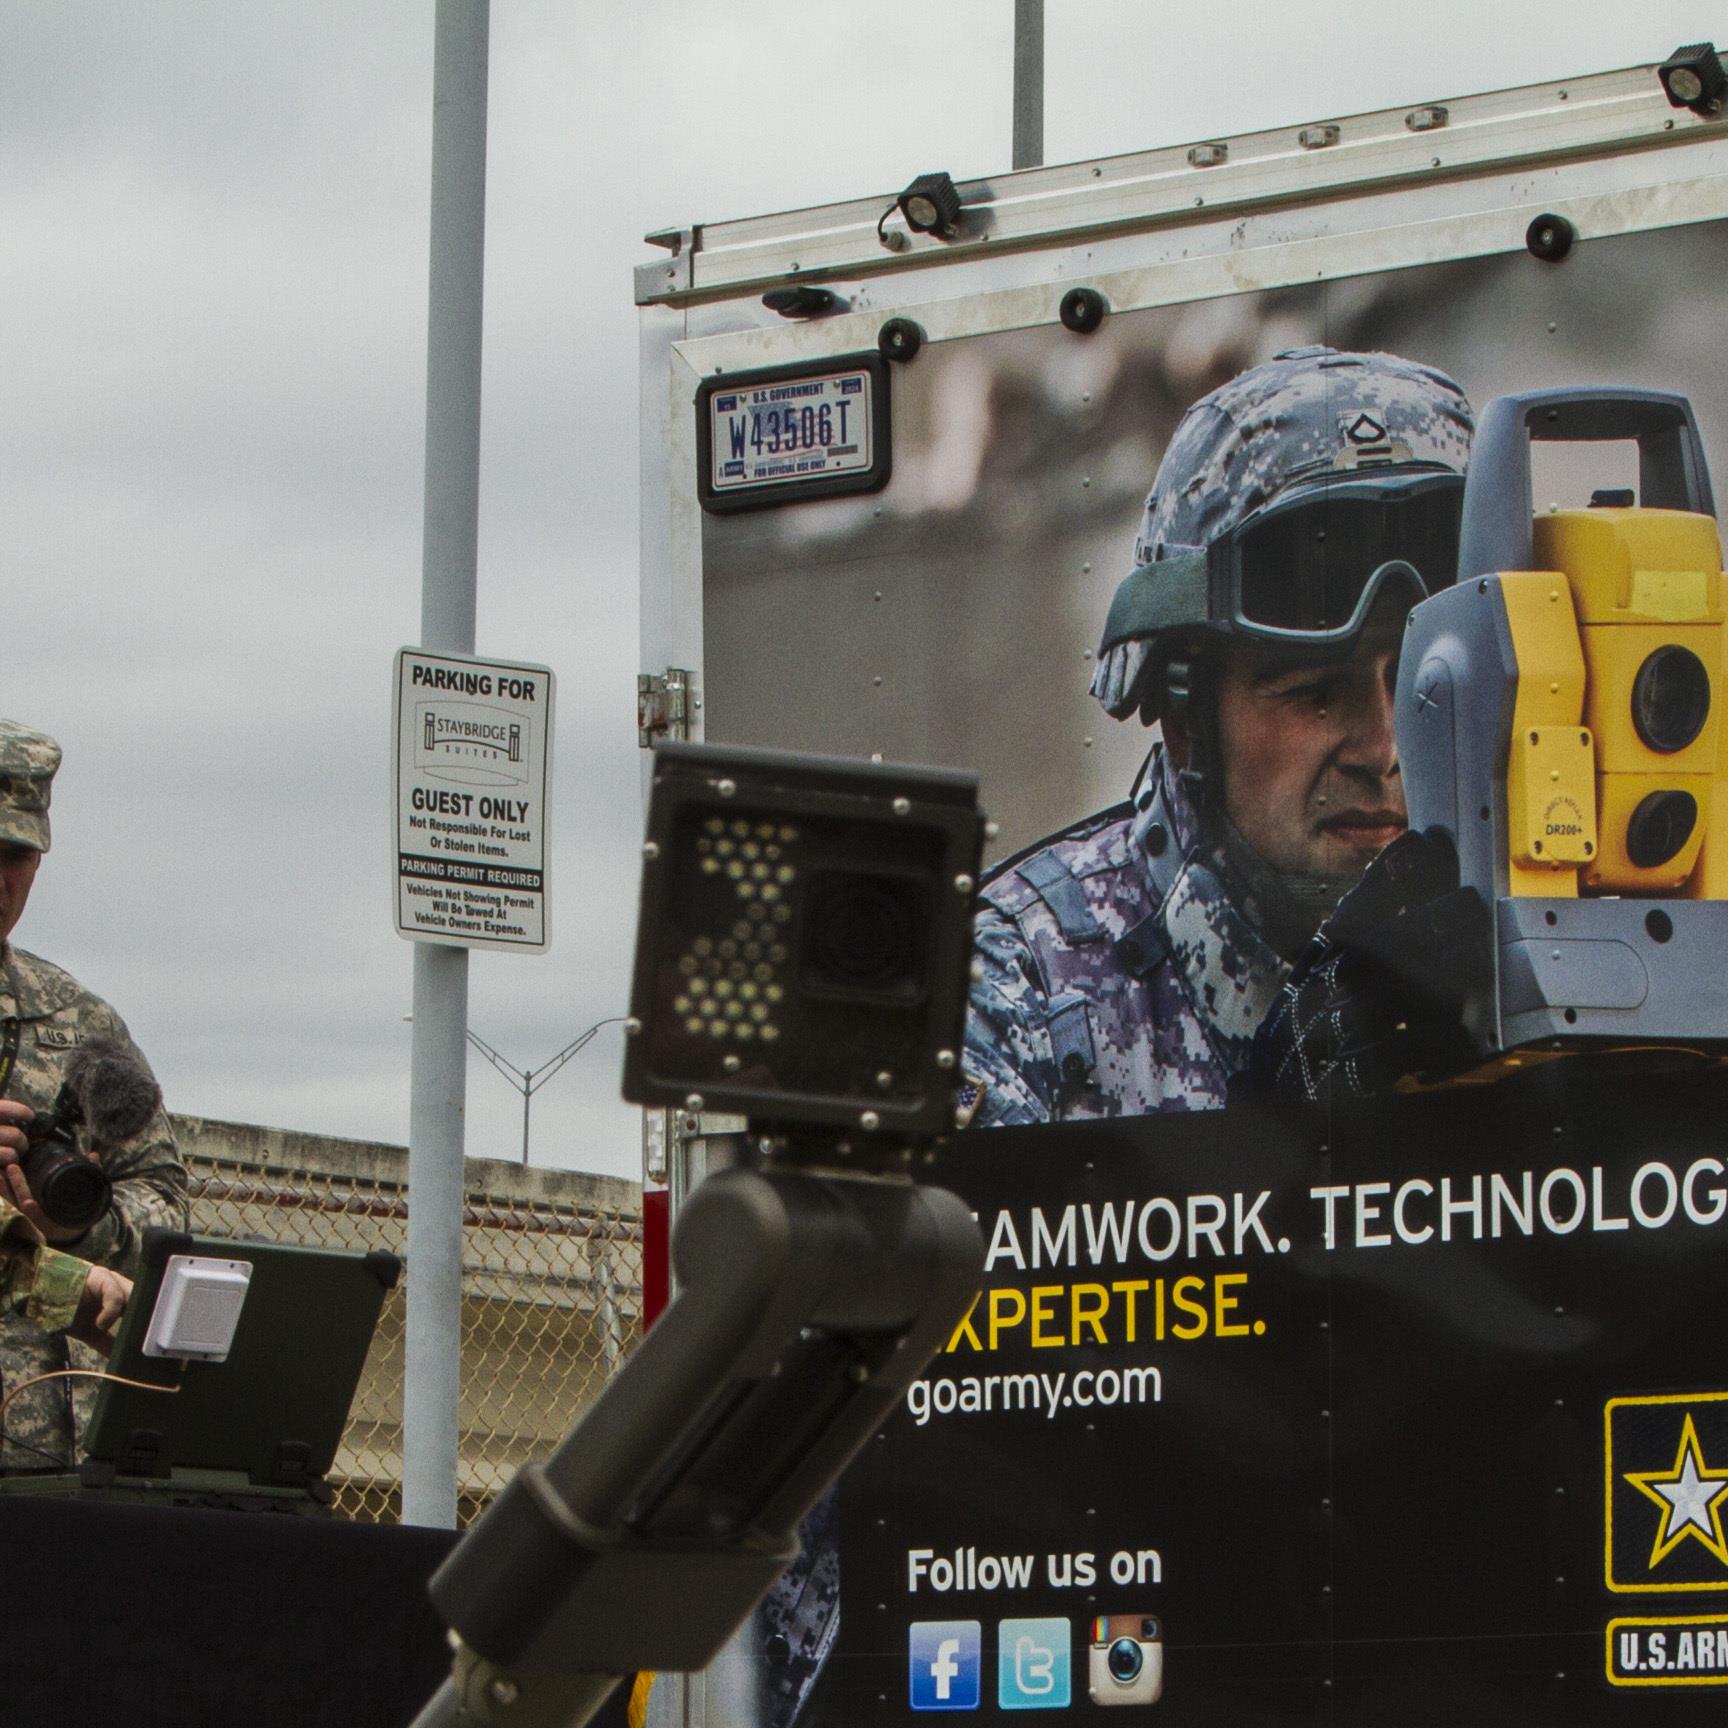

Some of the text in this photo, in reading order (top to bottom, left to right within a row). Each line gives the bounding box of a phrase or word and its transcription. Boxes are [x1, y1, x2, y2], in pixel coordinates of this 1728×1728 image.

[770, 383, 825, 401] GOVERNMENT
[728, 400, 851, 460] W43506T
[412, 665, 536, 702] PARKING FOR
[437, 718, 507, 741] STAYBRIDGE
[445, 744, 498, 760] SUITES
[412, 788, 529, 823] GUEST ONLY
[409, 815, 531, 842] Not Responsible For Lost
[430, 836, 509, 857] Or Stolen Items.
[401, 859, 541, 888] PARKING PERMIT REQUIRED
[406, 883, 534, 909] Vehicles Not Showing Permit
[432, 900, 508, 920] Will Be Towed At
[414, 911, 526, 936] Vehicle Owners Expense.
[970, 1190, 1291, 1271] AMWORK.
[935, 1273, 1266, 1353] XPERTISE.
[908, 1364, 1162, 1425] goarmy.com
[908, 1547, 1162, 1592] Follow us on
